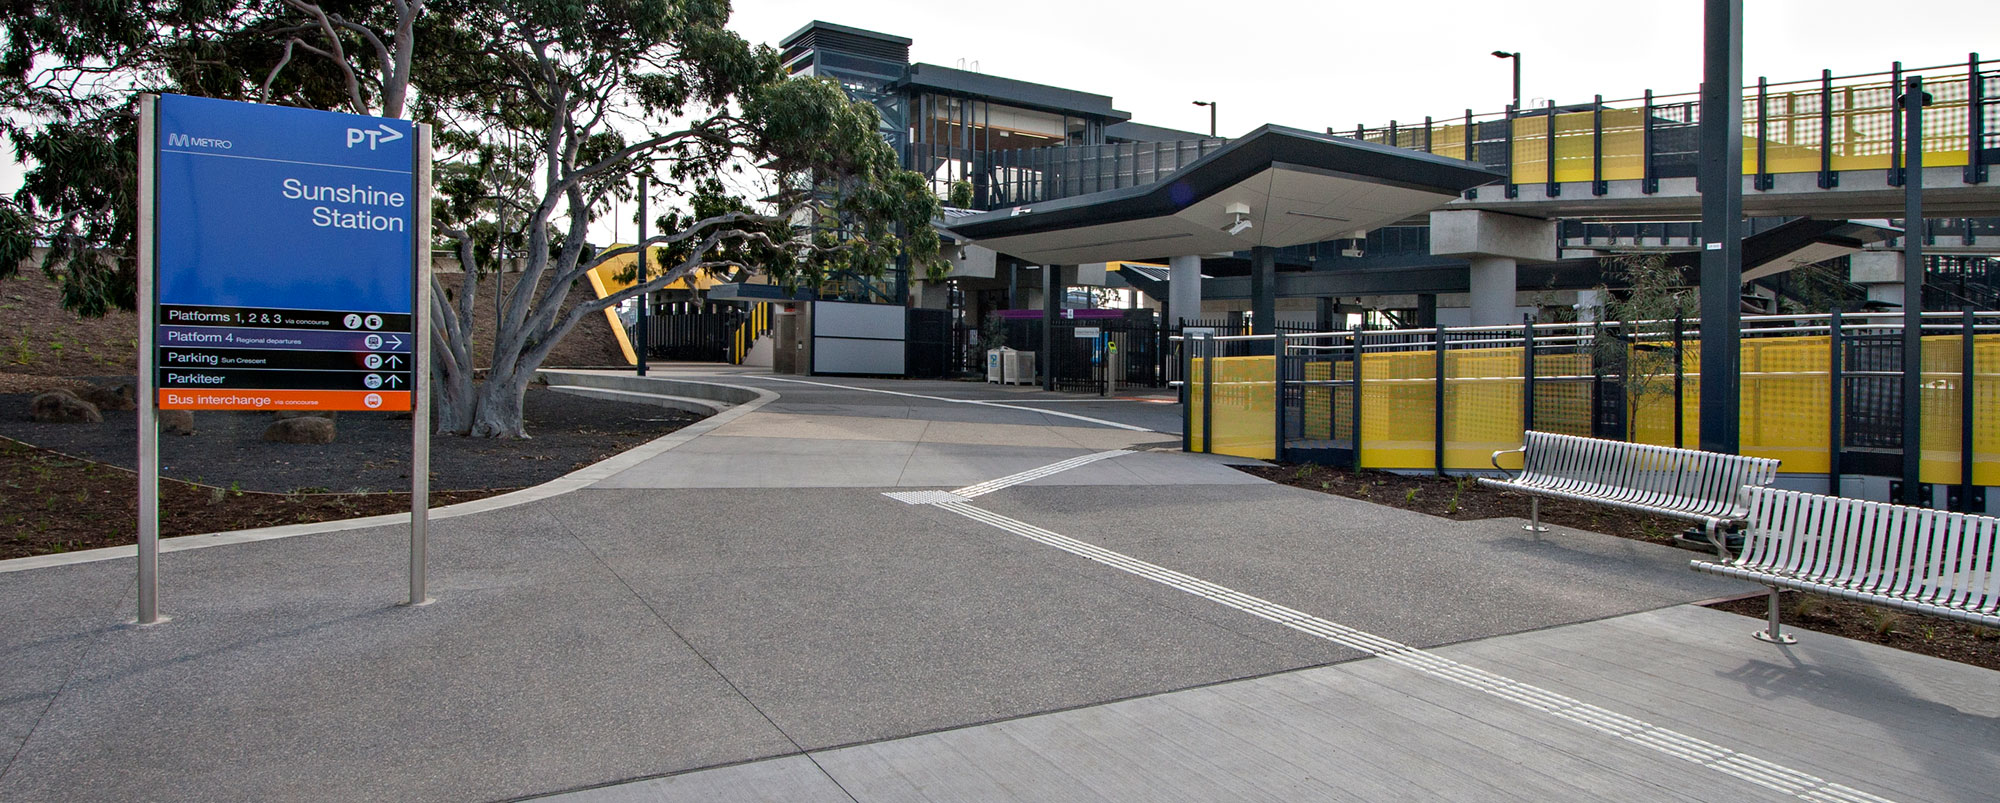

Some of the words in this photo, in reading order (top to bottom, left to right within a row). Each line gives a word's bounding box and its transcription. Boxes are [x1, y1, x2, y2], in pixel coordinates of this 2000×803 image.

[190, 136, 233, 150] METRO
[282, 177, 405, 208] Sunshine
[311, 206, 404, 232] Station
[169, 309, 231, 322] Platforms
[248, 313, 257, 323] 2
[260, 313, 271, 324] &
[273, 313, 282, 324] 3
[168, 331, 223, 343] Platform
[225, 332, 234, 343] 4
[236, 336, 266, 345] Regional
[266, 337, 302, 345] departures
[168, 351, 219, 366] Parking
[236, 357, 267, 365] Crescent
[168, 372, 226, 385] Parkiteer
[168, 394, 194, 405] Bus
[197, 394, 272, 408] interchange
